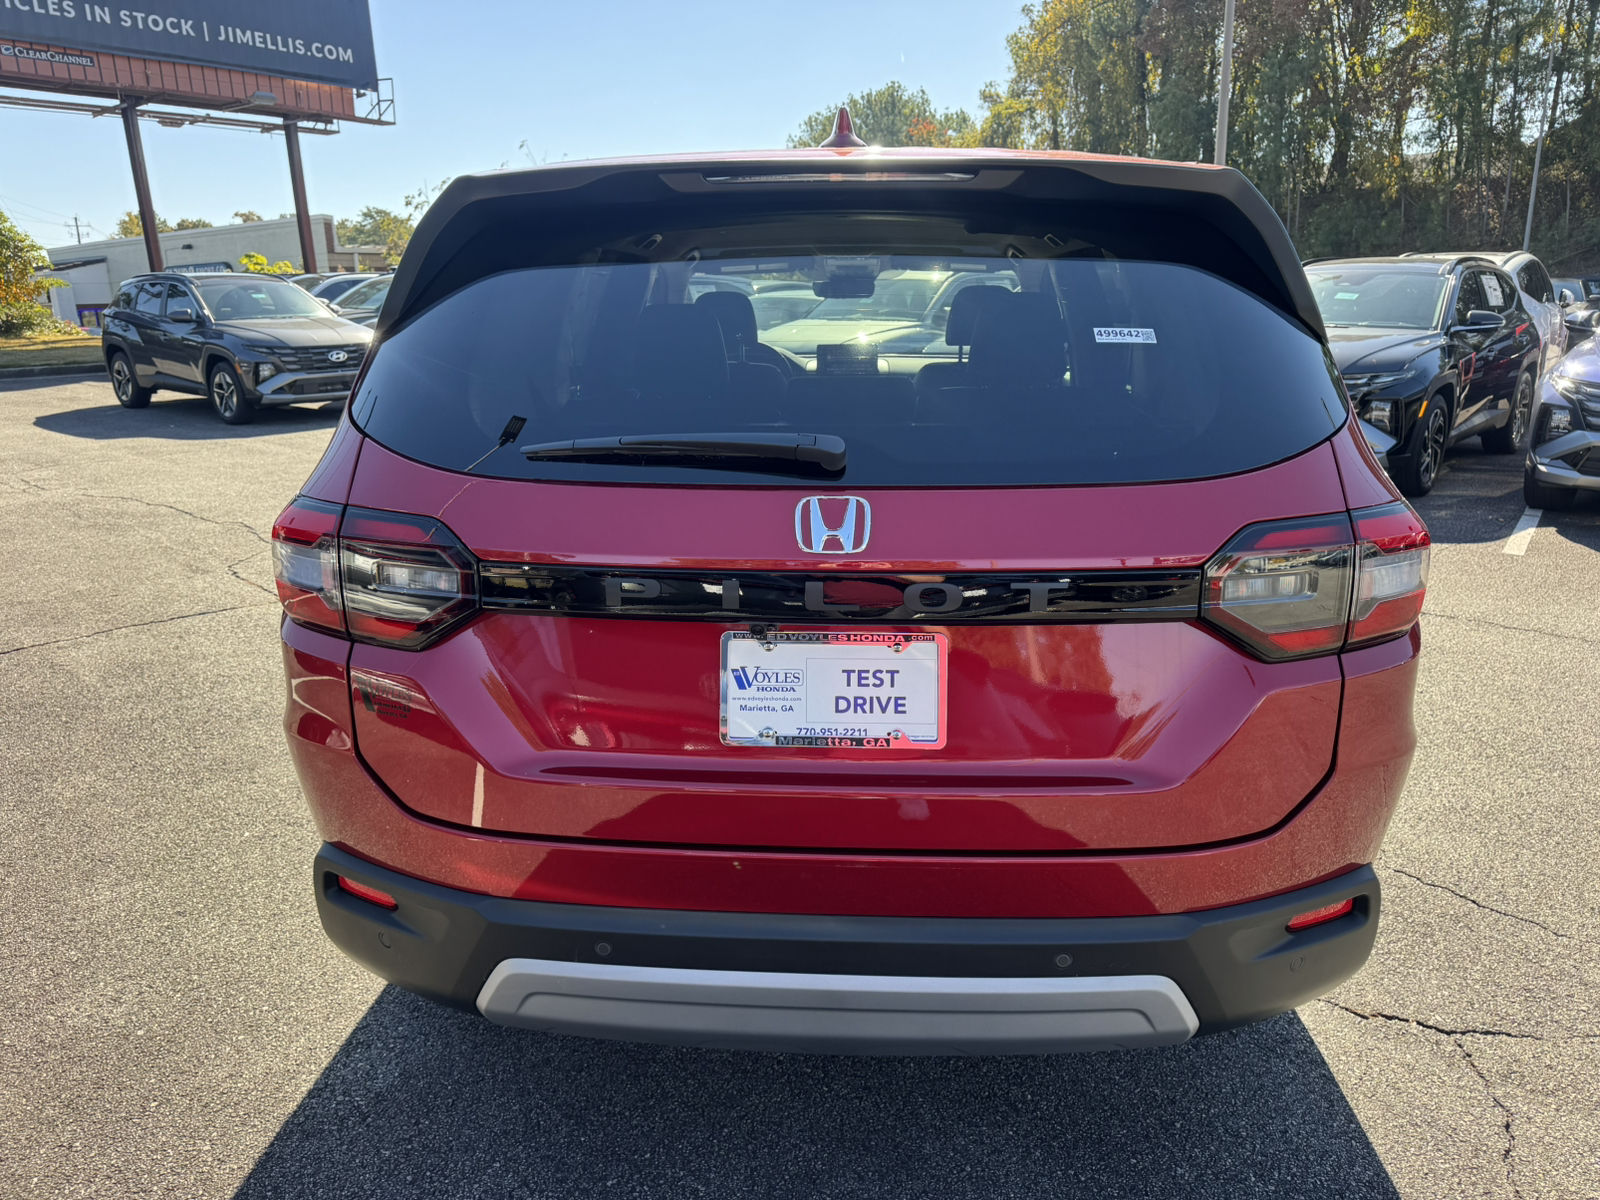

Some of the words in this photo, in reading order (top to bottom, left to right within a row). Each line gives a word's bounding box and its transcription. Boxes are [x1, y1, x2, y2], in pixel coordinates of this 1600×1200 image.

[84, 3, 111, 24] IN
[119, 10, 196, 37] STOCK
[218, 25, 354, 63] JIMELLIS.COM
[1096, 329, 1141, 338] 499642
[605, 577, 1069, 612] PILOT
[841, 669, 900, 688] TEST
[739, 704, 778, 713] Marietta,
[780, 704, 794, 712] GA
[834, 696, 907, 714] DRIVE
[796, 727, 868, 737] 770-951-2211
[778, 736, 856, 747] Marietta,
[863, 738, 888, 747] GA
